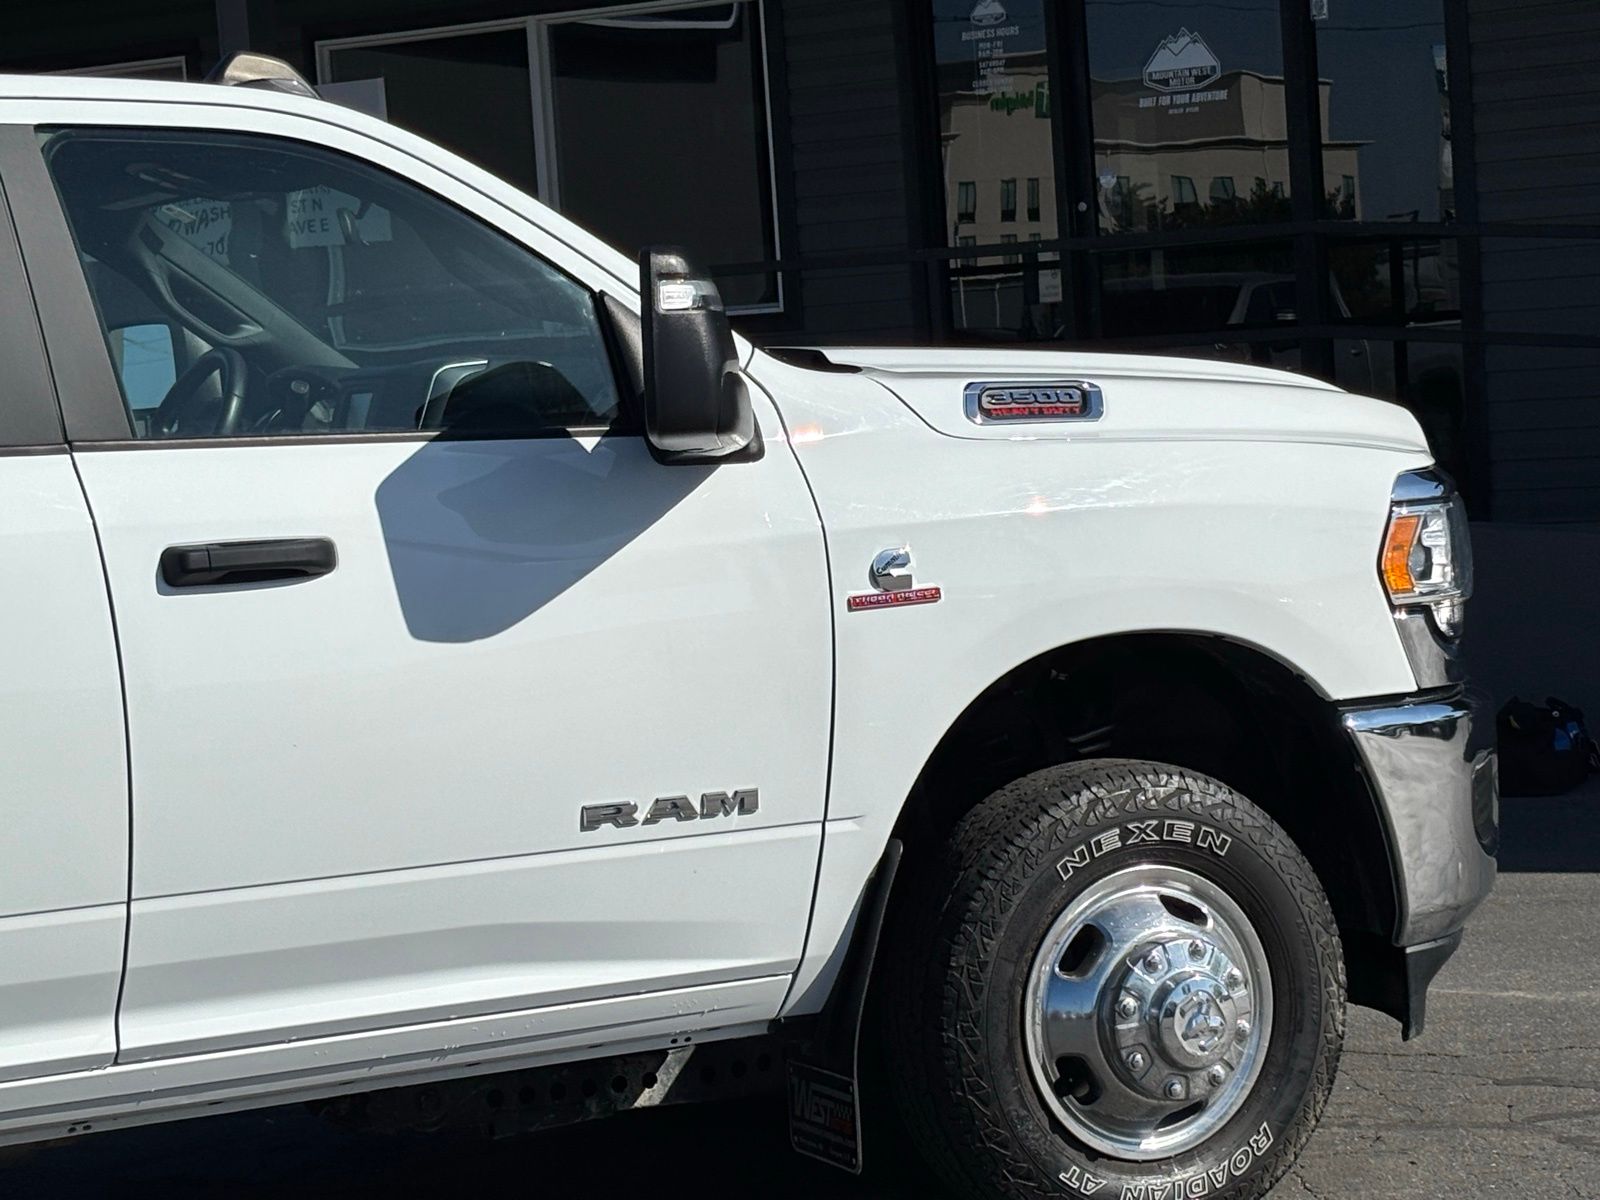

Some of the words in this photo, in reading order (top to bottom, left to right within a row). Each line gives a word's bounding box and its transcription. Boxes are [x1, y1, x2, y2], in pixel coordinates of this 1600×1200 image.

[961, 29, 995, 41] BUSINESS
[996, 26, 1020, 36] HOURS
[1152, 69, 1190, 80] MOUNTAIN
[1191, 66, 1211, 76] WEST
[1169, 77, 1196, 87] MOTOR
[1158, 95, 1171, 106] FOR
[1173, 93, 1190, 105] YOUR
[1191, 89, 1229, 103] ADVENTURE
[981, 387, 1083, 409] 3500
[580, 787, 759, 832] RAM
[1056, 820, 1231, 881] NEXEN
[1120, 1121, 1274, 1200] ROADIAN
[1059, 1166, 1107, 1195] AT
